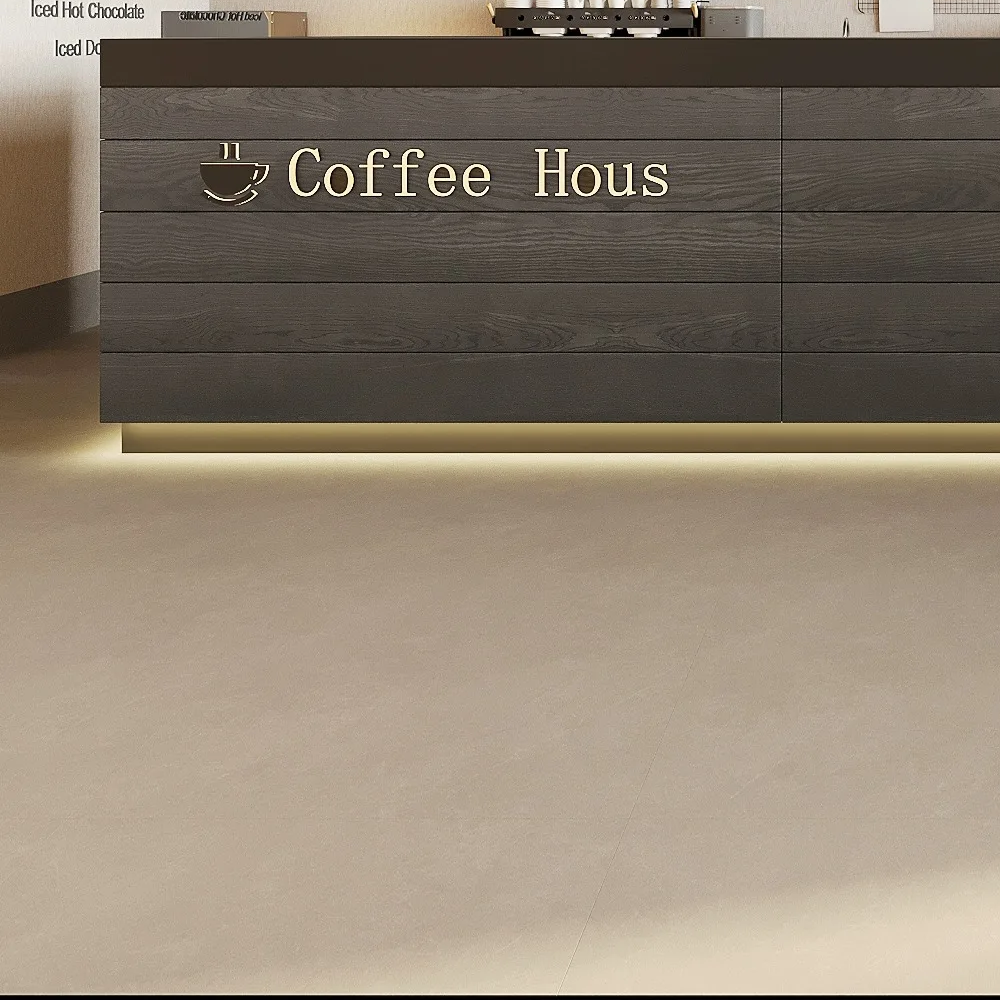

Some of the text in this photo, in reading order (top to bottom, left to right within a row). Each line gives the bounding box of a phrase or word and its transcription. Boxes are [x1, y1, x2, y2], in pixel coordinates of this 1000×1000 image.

[32, 0, 144, 19] Iced Hot Chocolate
[55, 40, 82, 56] Iced
[288, 148, 669, 197] Coffee Hous
